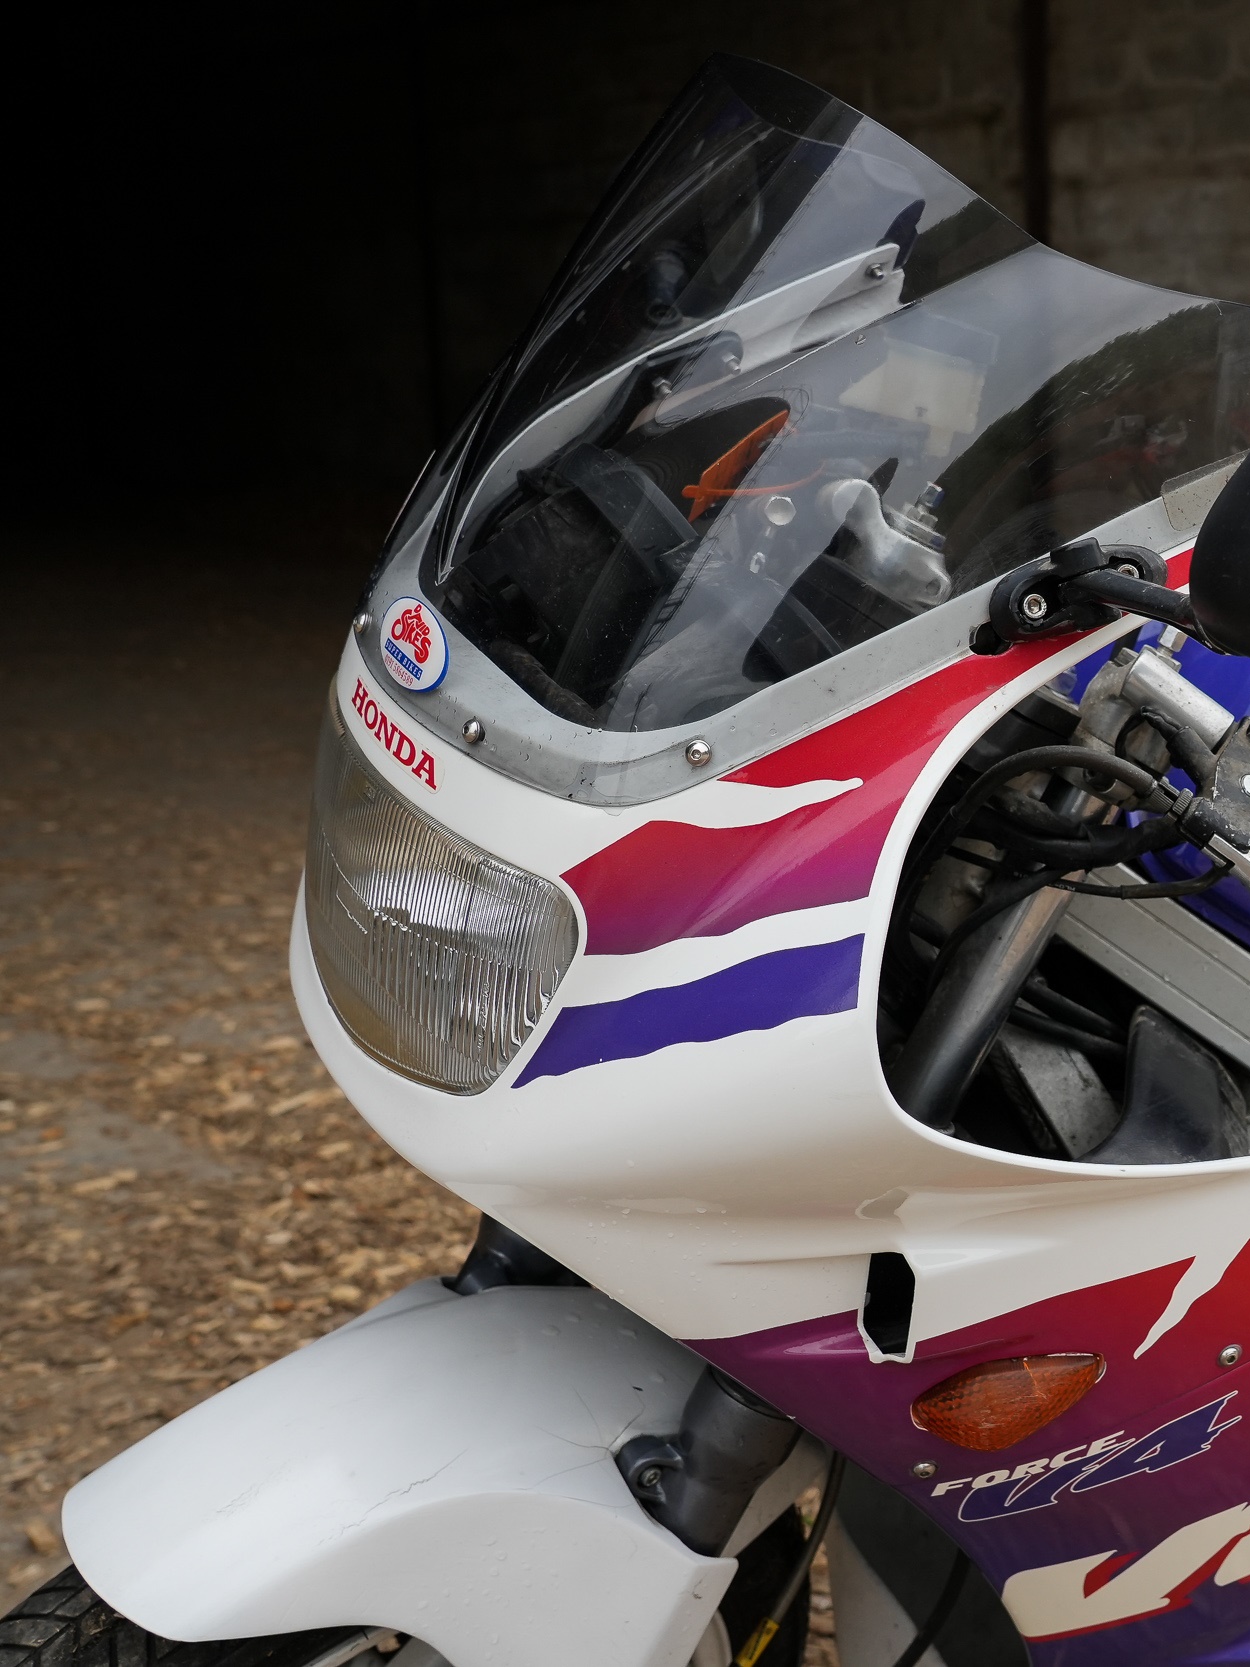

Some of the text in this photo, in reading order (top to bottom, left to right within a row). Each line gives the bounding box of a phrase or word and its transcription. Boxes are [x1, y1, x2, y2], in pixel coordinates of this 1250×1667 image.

[402, 658, 423, 678] BIKES
[351, 677, 437, 791] HONDA
[930, 1429, 1125, 1496] FORCE
